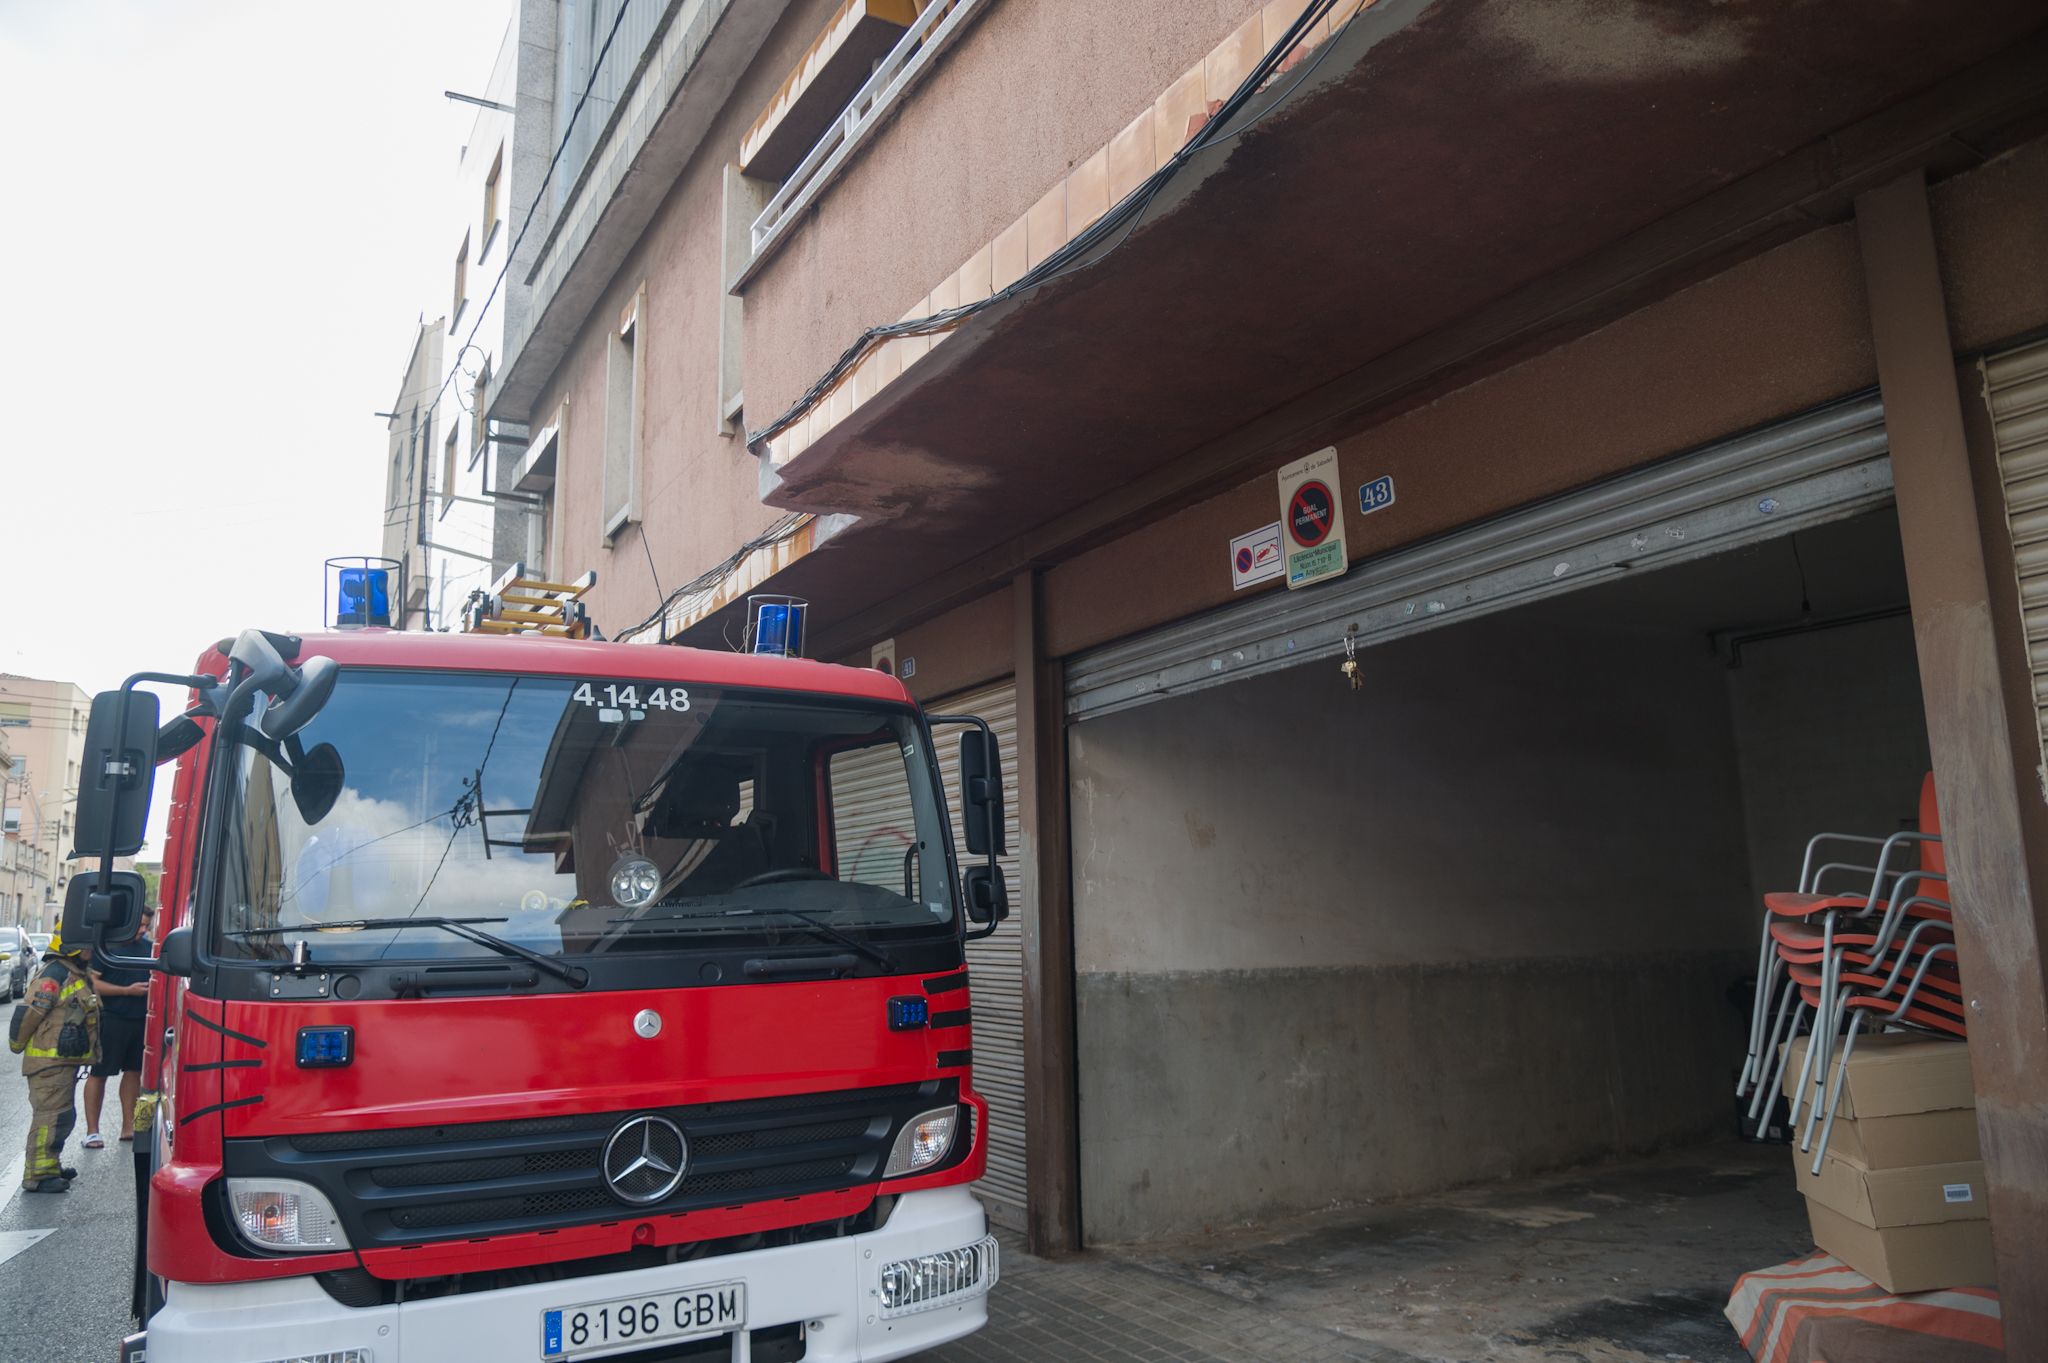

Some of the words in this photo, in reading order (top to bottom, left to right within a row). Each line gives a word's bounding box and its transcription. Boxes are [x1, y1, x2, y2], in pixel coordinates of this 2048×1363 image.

[1364, 482, 1388, 506] 43
[1295, 508, 1327, 526] PERMANENT
[573, 682, 691, 712] 4.14.48
[570, 1301, 660, 1345] 8196
[674, 1289, 737, 1329] GBM
[549, 1337, 557, 1348] E
